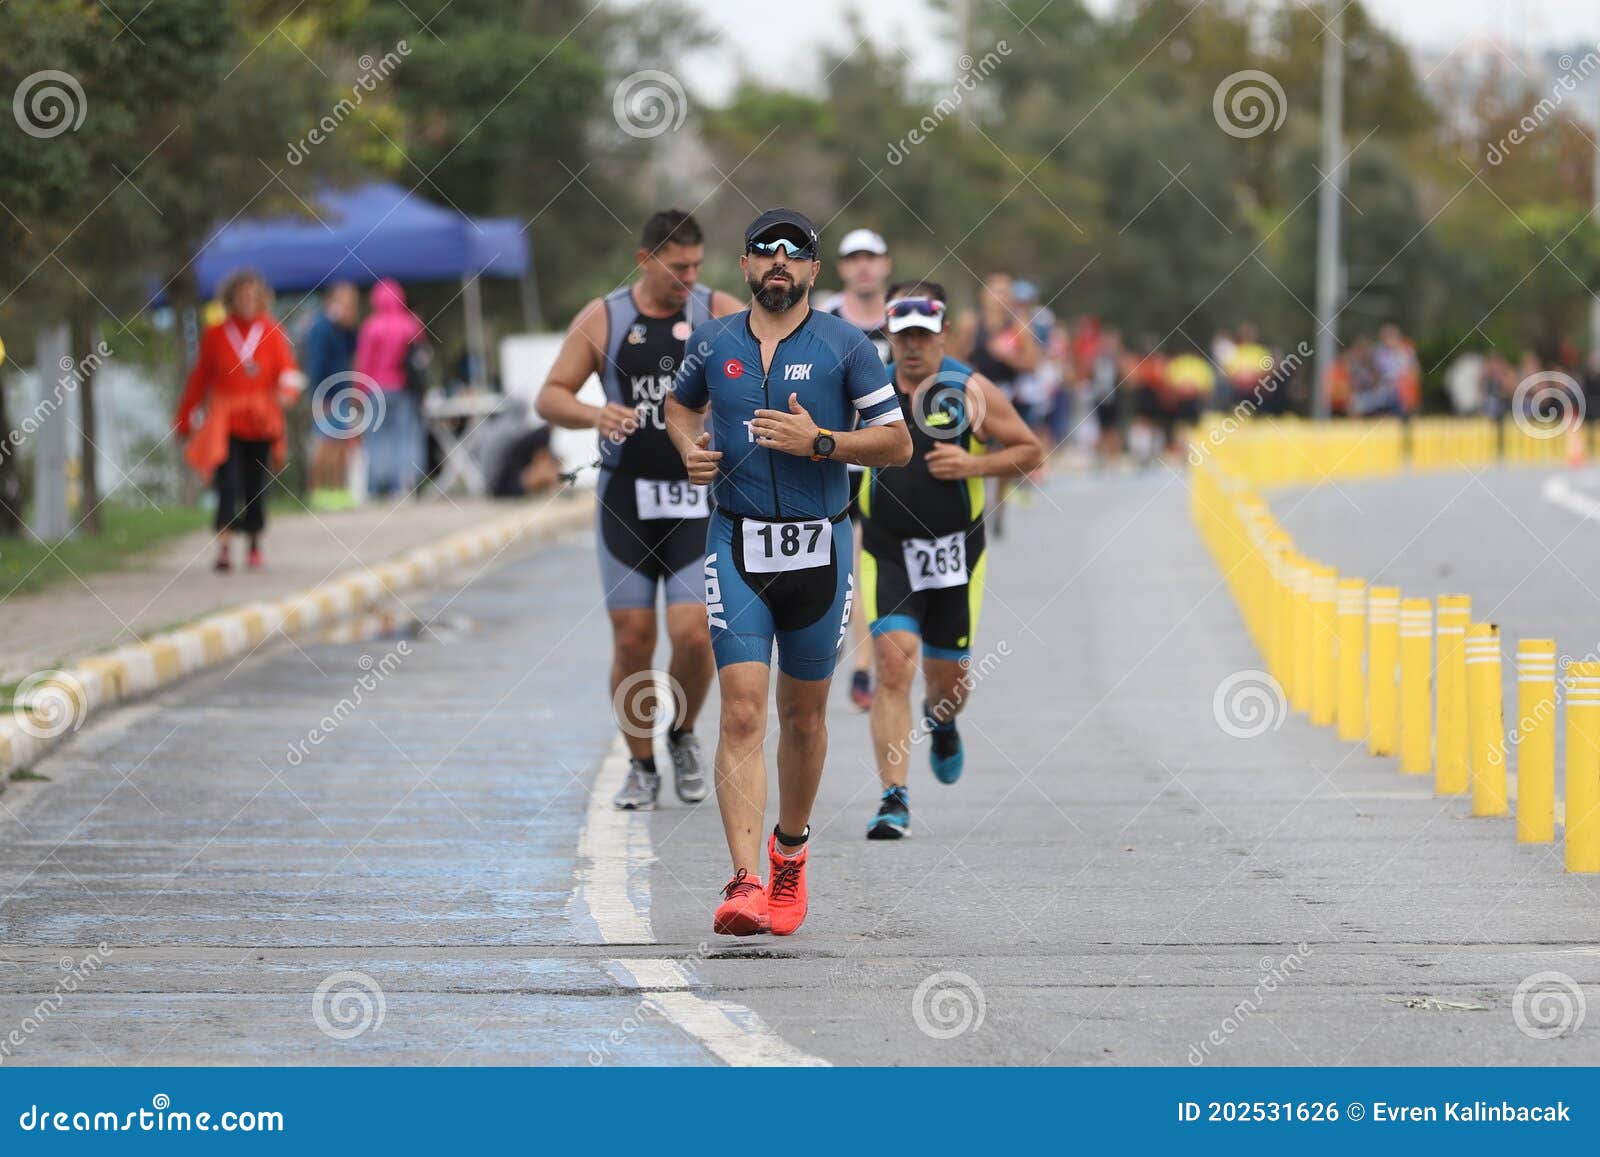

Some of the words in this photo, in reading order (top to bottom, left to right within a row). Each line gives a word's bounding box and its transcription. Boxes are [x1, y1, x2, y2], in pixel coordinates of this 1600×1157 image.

[784, 363, 813, 380] YBK
[651, 482, 699, 506] 195
[757, 523, 824, 558] 187
[916, 545, 961, 576] 263
